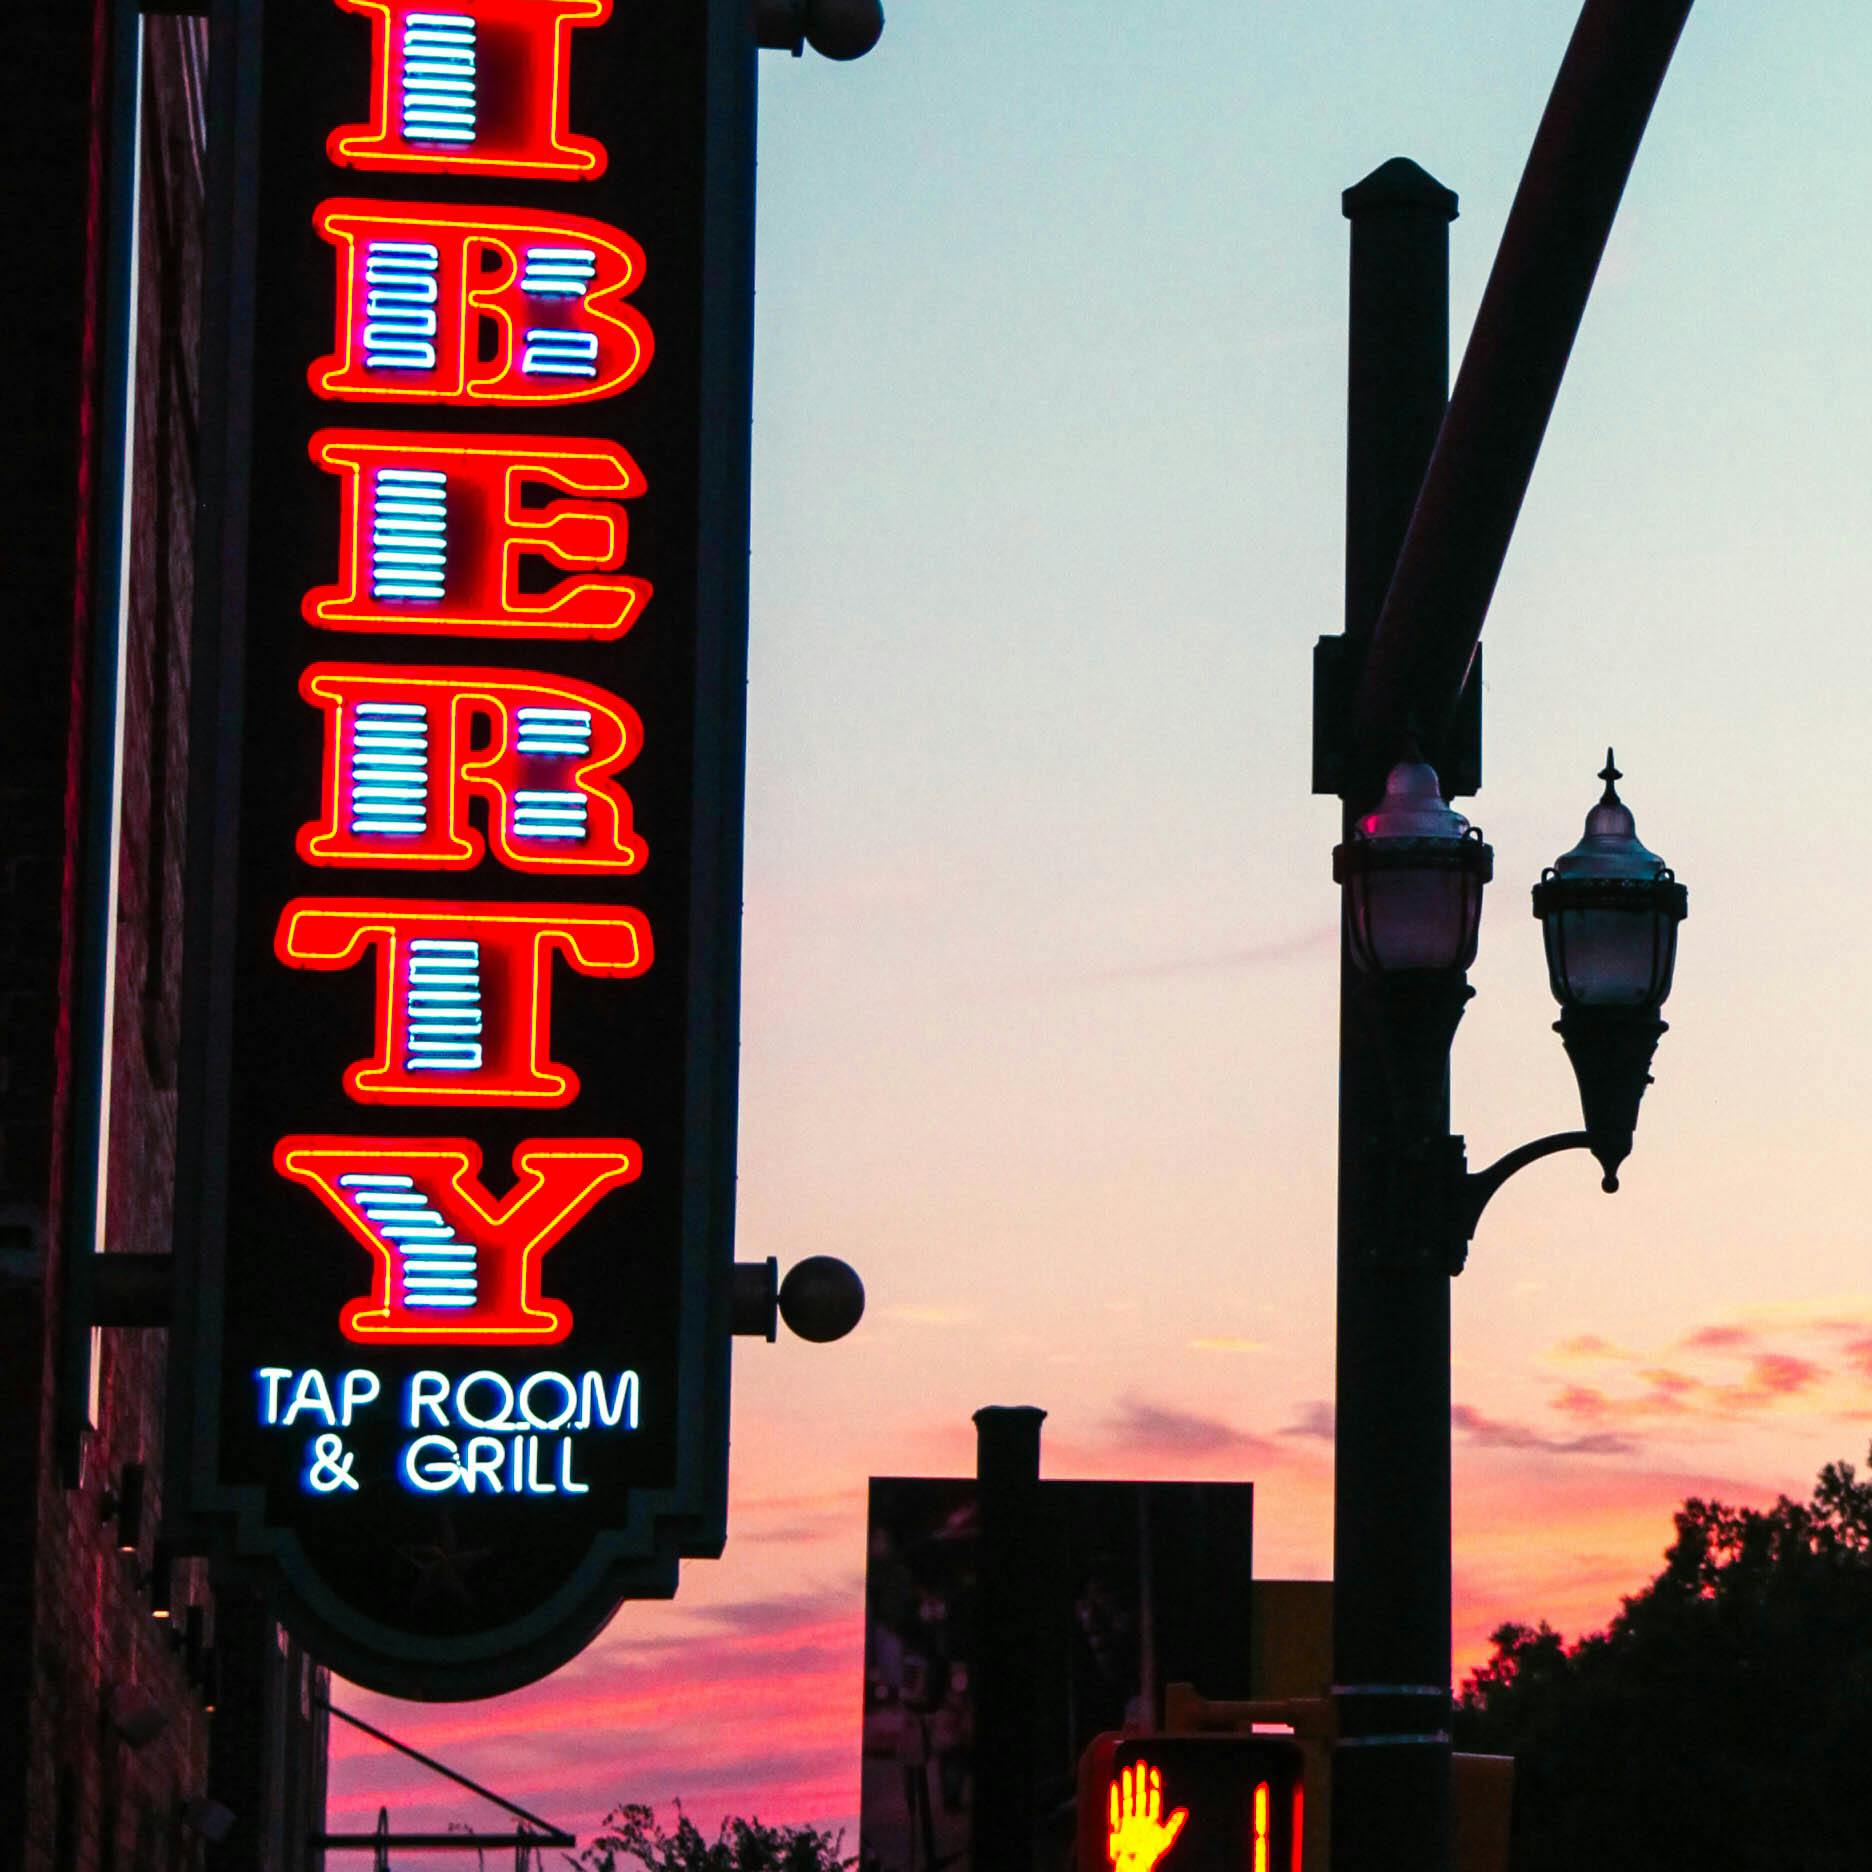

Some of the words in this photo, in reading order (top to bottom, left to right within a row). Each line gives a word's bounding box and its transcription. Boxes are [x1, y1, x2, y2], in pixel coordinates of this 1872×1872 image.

[258, 1366, 380, 1427] TAP
[408, 1369, 640, 1431] ROOM
[308, 1432, 360, 1493] &
[403, 1433, 590, 1494] GRILL
